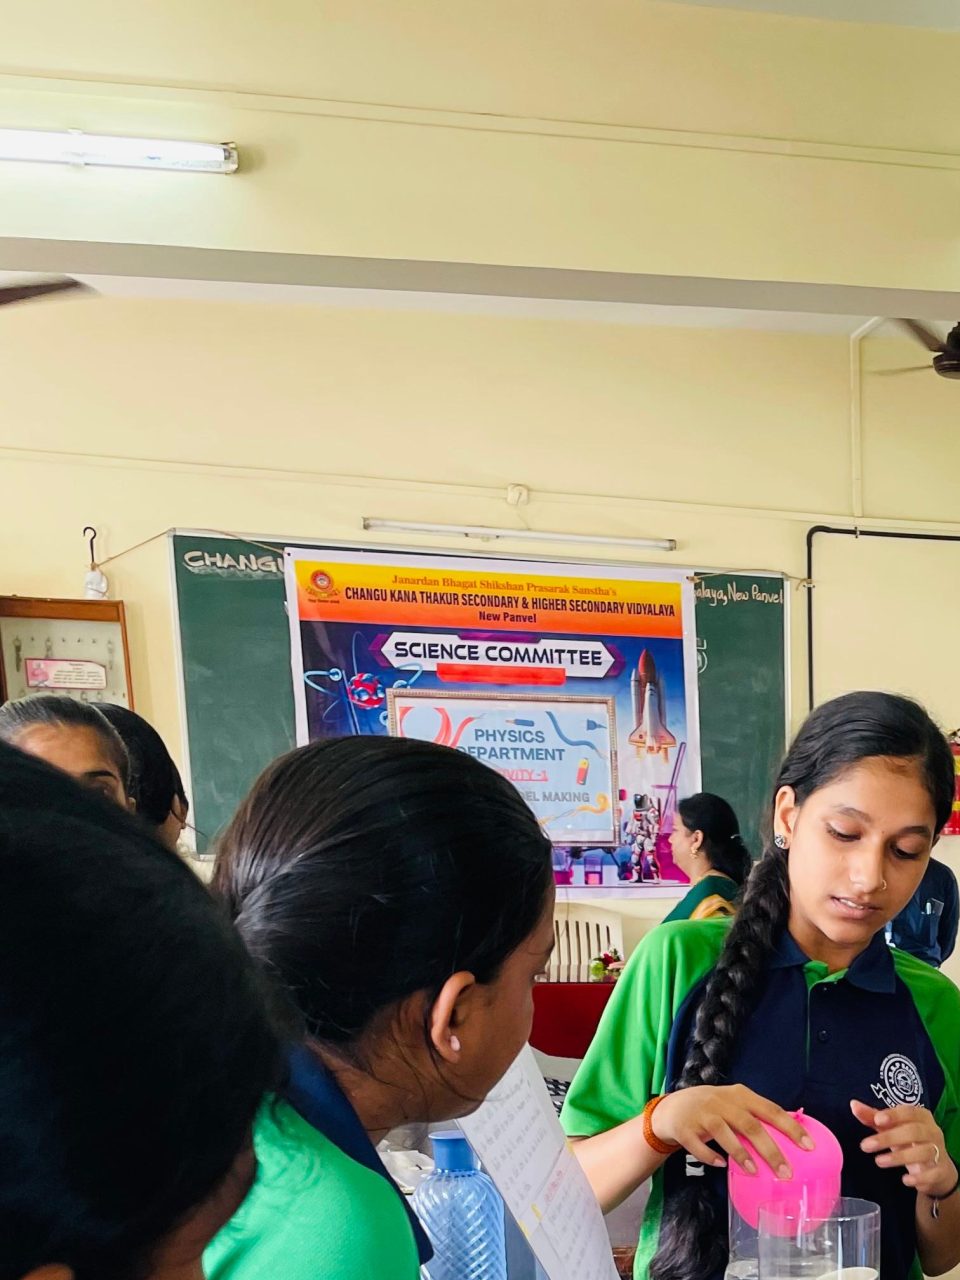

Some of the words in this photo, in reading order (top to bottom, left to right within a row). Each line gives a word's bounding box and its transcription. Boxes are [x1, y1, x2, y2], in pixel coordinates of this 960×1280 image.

[392, 575, 440, 587] Janardan
[442, 577, 477, 590] Bhagat
[480, 580, 524, 591] Shikshan
[526, 583, 569, 594] Prasarak
[572, 585, 617, 596] Sanstha's
[727, 581, 749, 602] New
[751, 584, 784, 604] Panvel
[345, 586, 387, 601] CHANGU
[390, 589, 418, 603] KANA
[419, 591, 459, 606] THAKUR
[461, 593, 519, 609] SECONDARY
[522, 596, 529, 609] &
[532, 597, 567, 611] HIGHER
[569, 599, 625, 614] SECONDARY
[626, 601, 675, 617] VIDYALAYA
[478, 611, 500, 622] New
[503, 612, 537, 623] Panvel
[394, 641, 480, 661] SCIENCE
[485, 645, 603, 666] COMMITTEE
[474, 728, 546, 744] PHYSICS
[542, 791, 591, 803] MAKING
